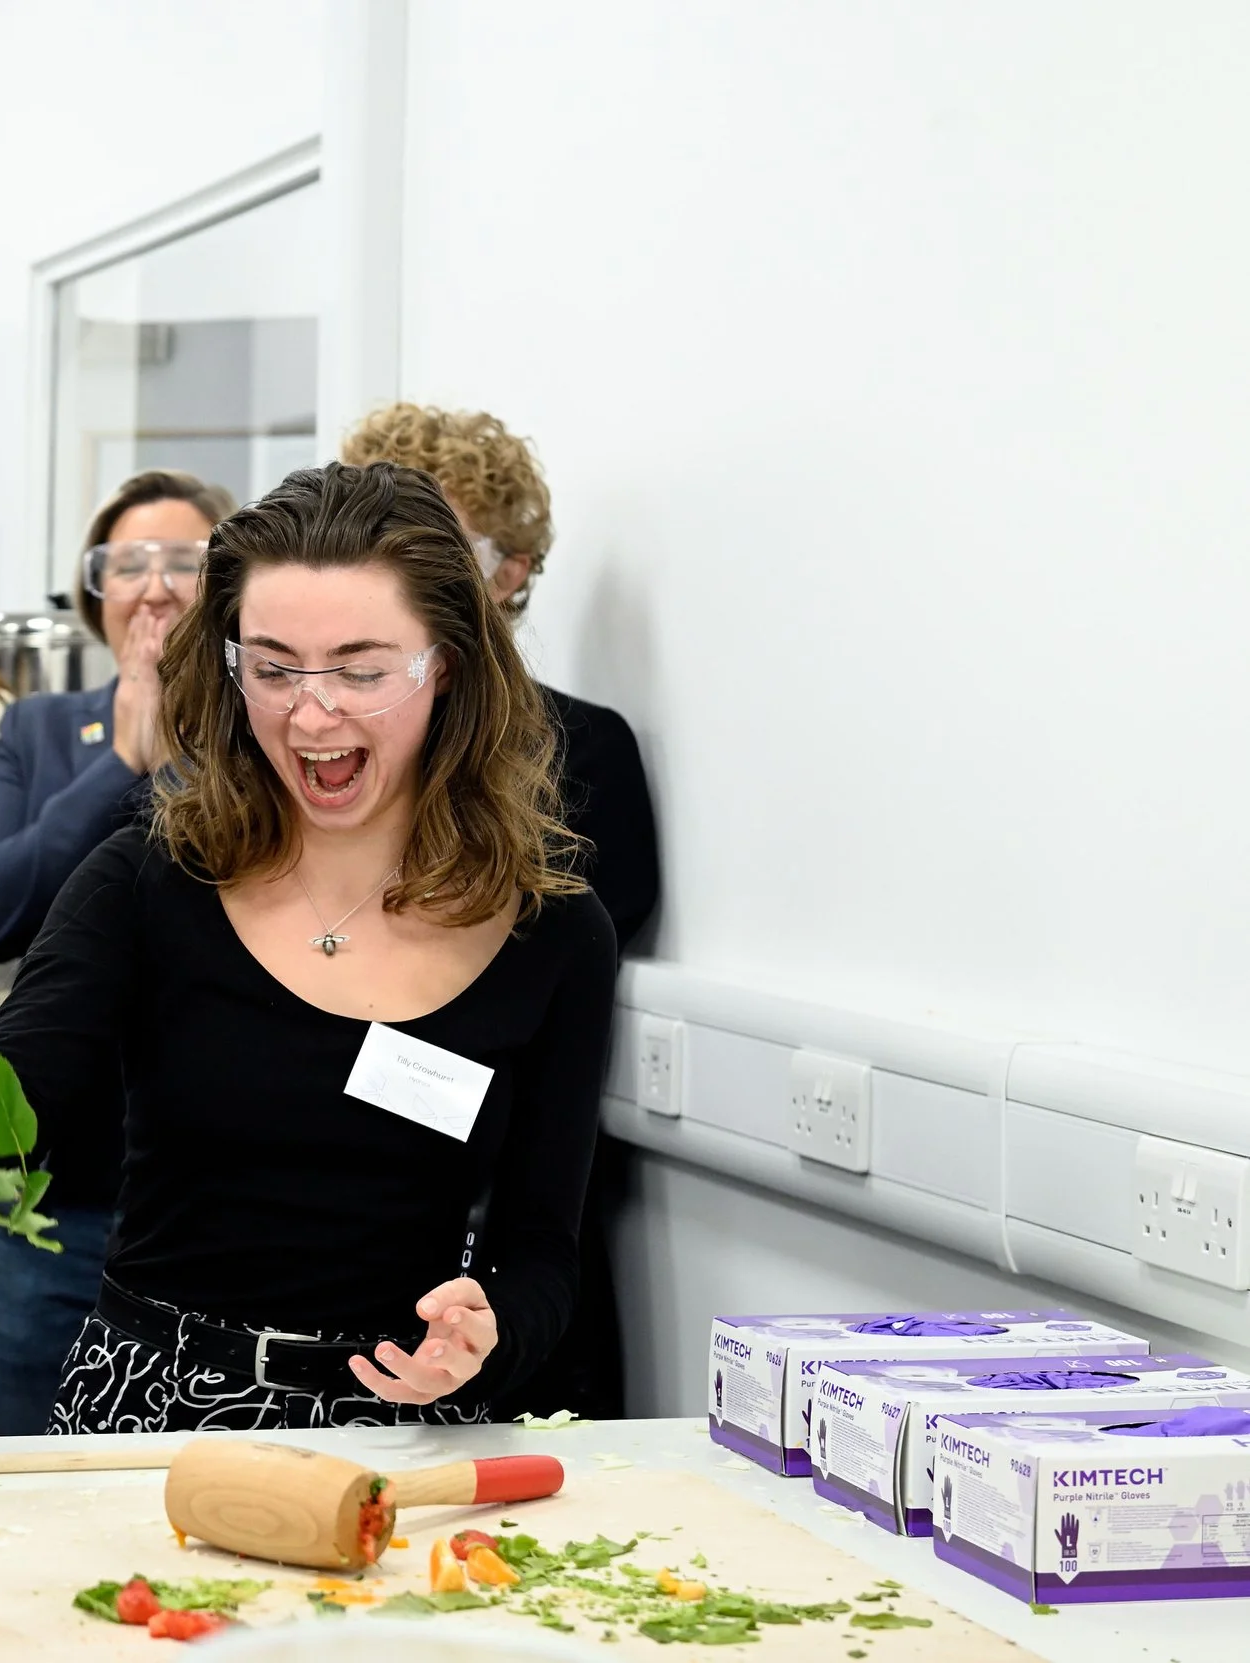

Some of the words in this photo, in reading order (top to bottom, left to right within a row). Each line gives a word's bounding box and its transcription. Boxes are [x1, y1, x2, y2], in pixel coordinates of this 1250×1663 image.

[397, 1055, 412, 1067] Tilly
[412, 1062, 454, 1082] Crowhurst
[714, 1332, 752, 1360] KIMTECH
[765, 1351, 782, 1367] 90626
[1104, 1358, 1142, 1367] 100
[819, 1379, 864, 1411] KIMTECH
[881, 1402, 901, 1420] 90627
[941, 1433, 990, 1468] KIMTECH
[1053, 1468, 1163, 1487] KIMTECH
[1053, 1493, 1083, 1503] Purple
[1121, 1491, 1151, 1500] Gloves
[1066, 1535, 1073, 1547] L
[1059, 1560, 1078, 1572] 100
